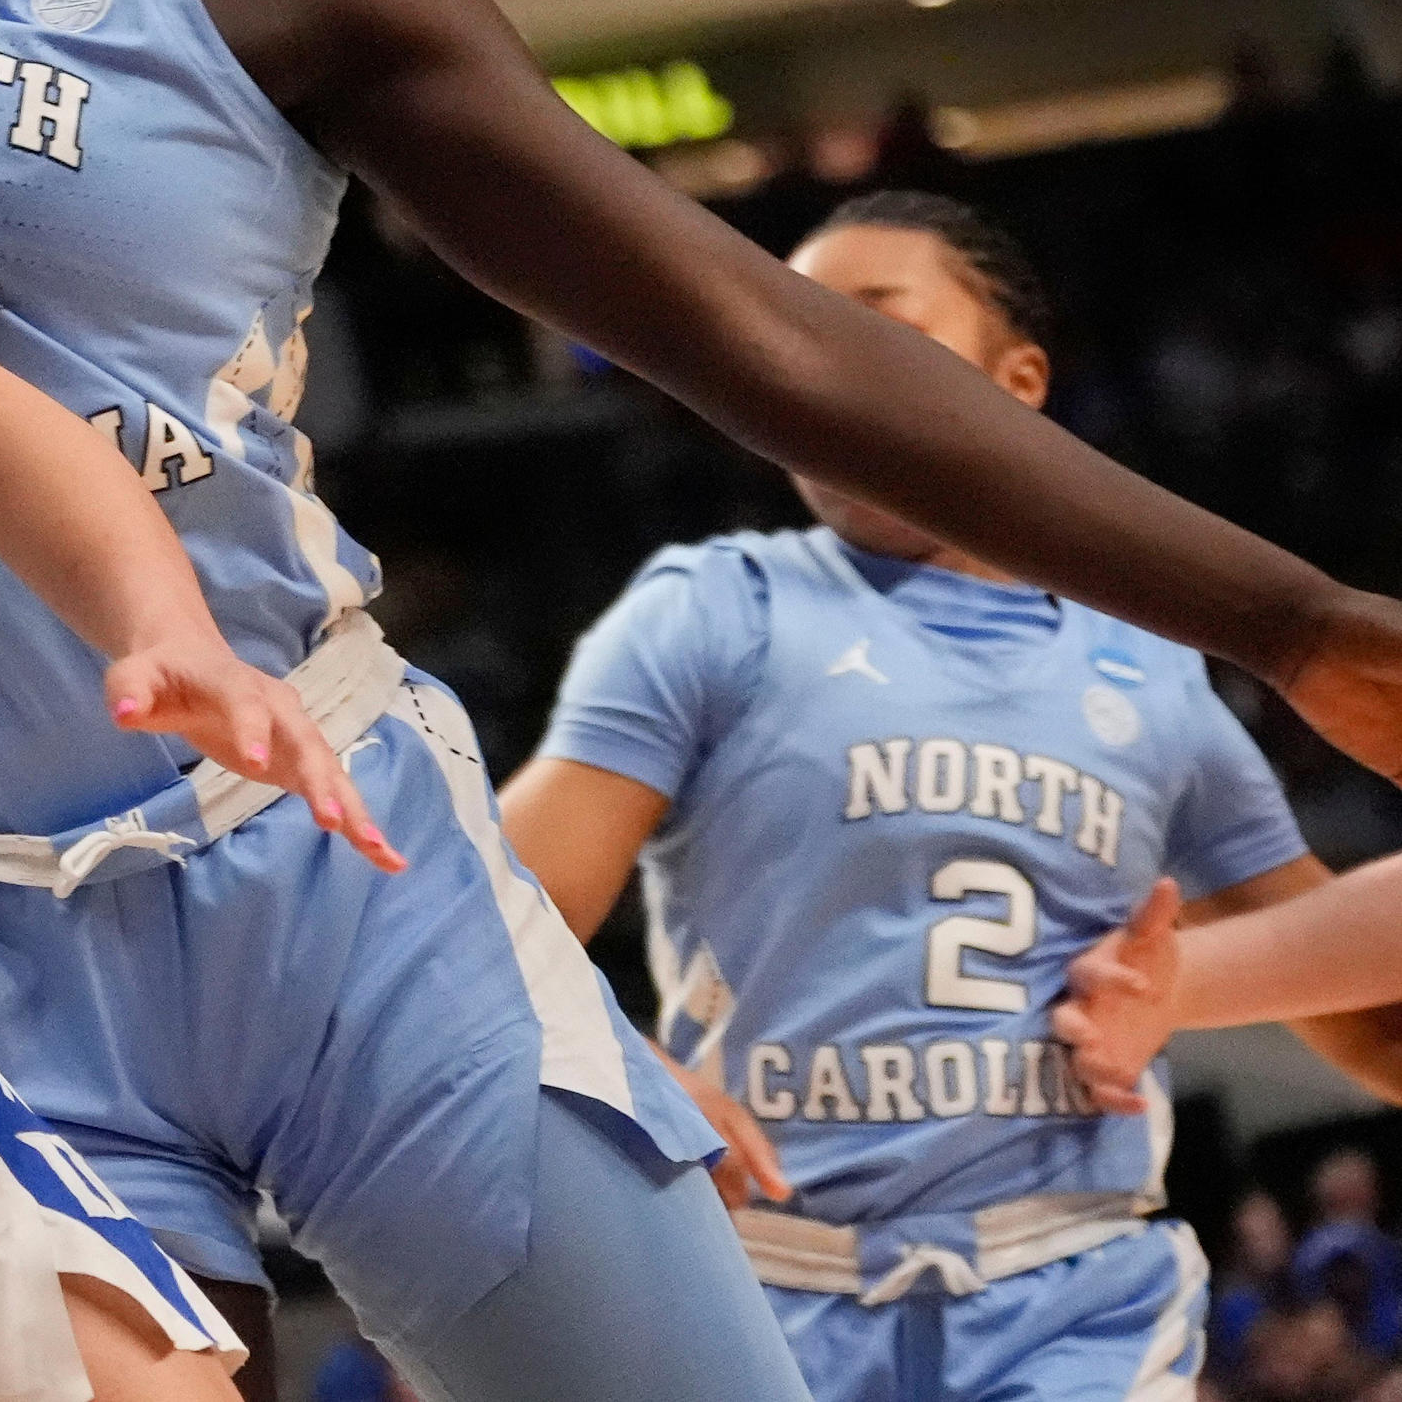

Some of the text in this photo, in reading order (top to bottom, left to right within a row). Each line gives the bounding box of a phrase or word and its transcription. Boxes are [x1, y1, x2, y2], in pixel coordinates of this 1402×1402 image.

[843, 737, 1126, 869] NORTH
[926, 858, 1040, 1015] 2
[746, 1037, 1101, 1124] CAROLIN
